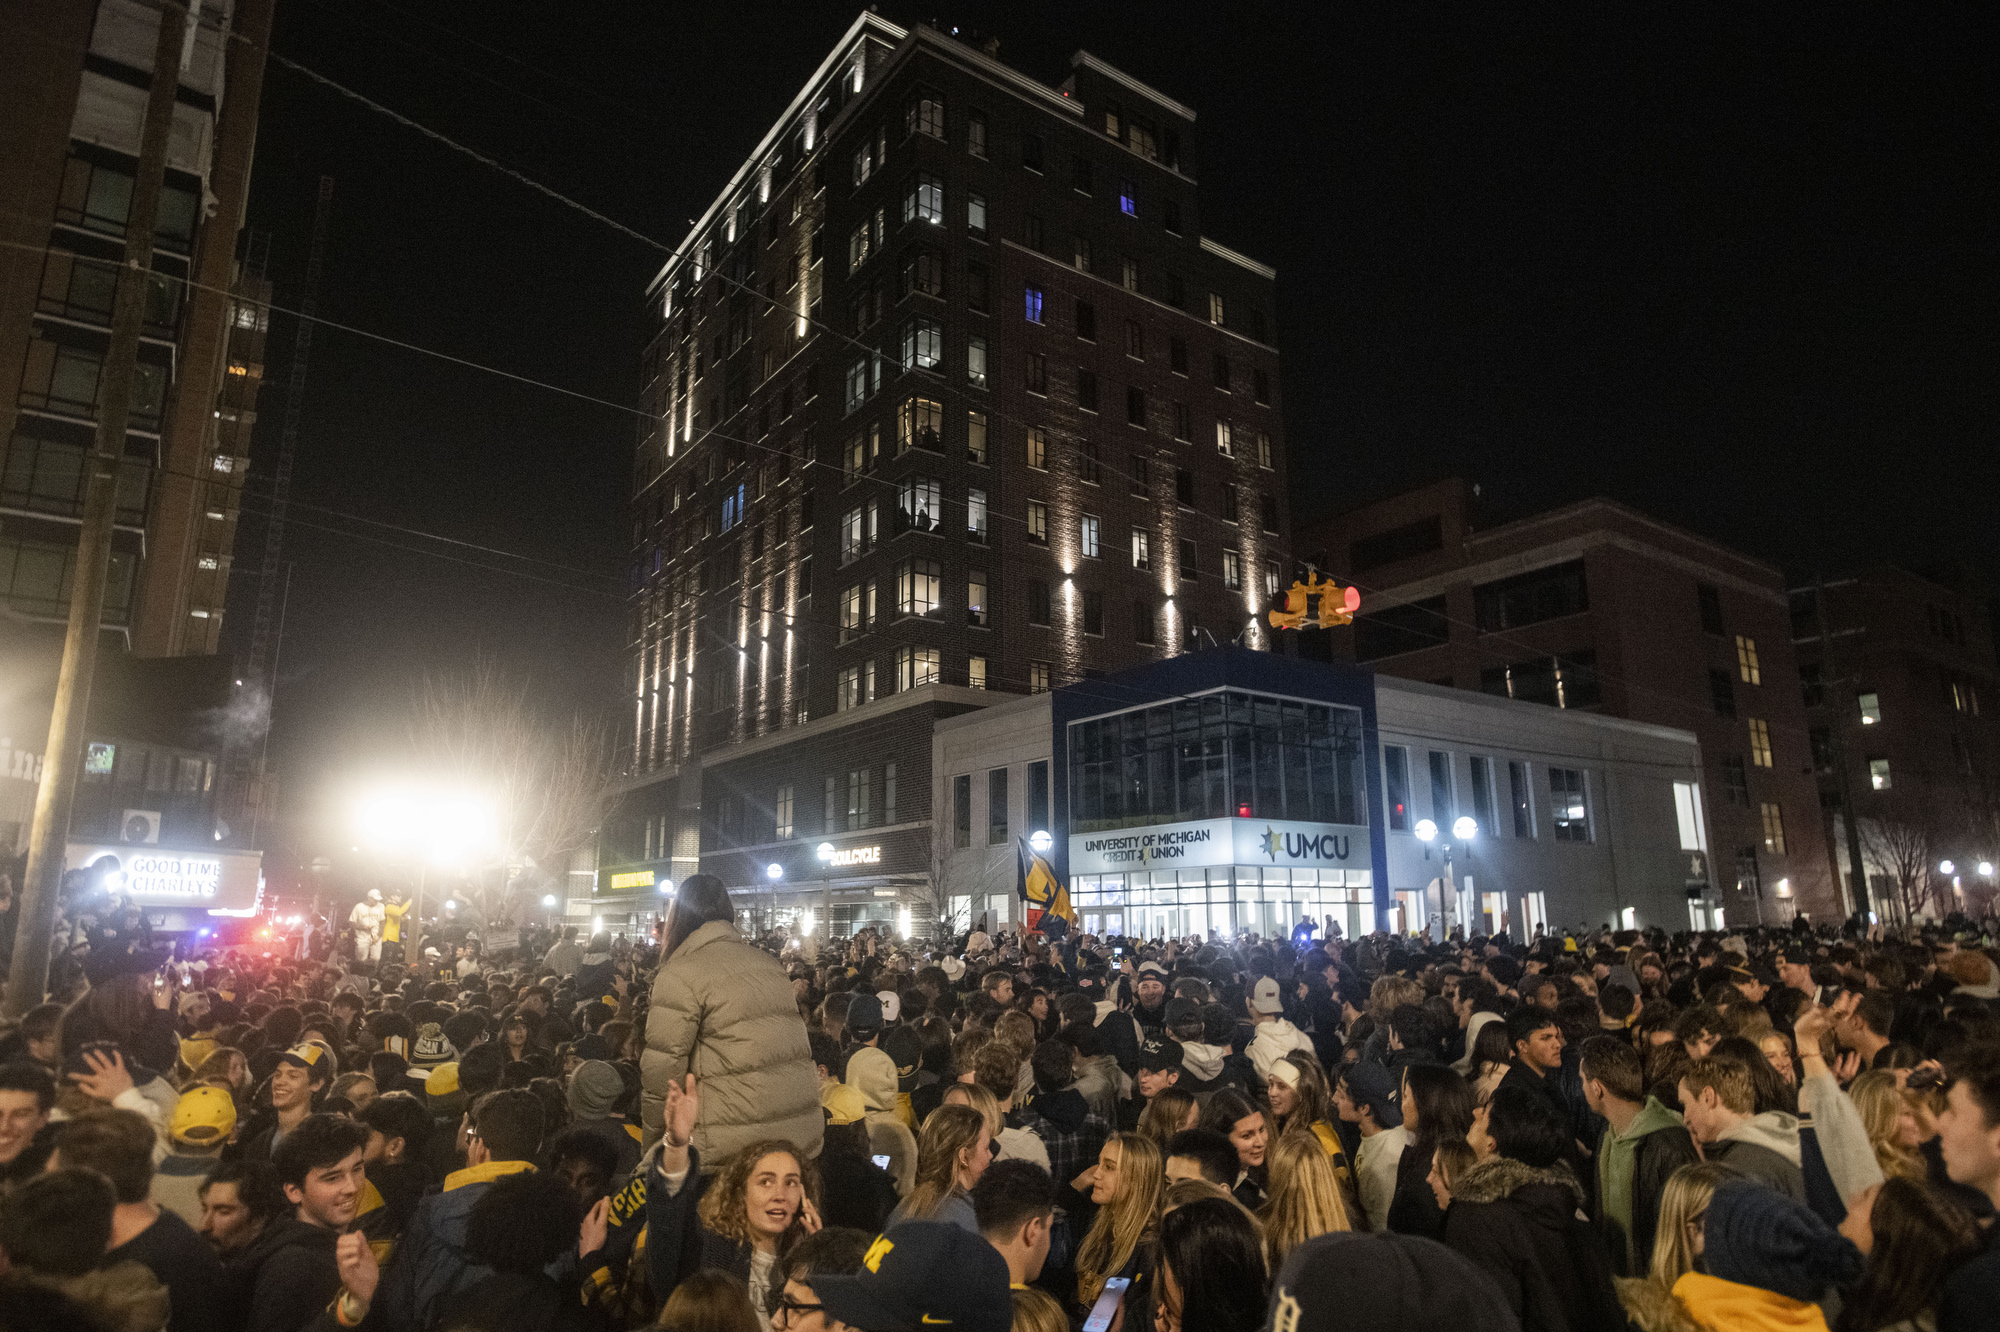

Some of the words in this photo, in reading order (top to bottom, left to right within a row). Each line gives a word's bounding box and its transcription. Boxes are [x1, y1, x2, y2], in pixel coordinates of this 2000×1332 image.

[1085, 836, 1140, 852] UNIVERSITY
[1142, 834, 1156, 847] OF
[1158, 829, 1210, 846] MICHIGAN
[1286, 832, 1350, 860] UMCU
[1102, 850, 1136, 863] CREDIT
[1151, 845, 1184, 859] UNION
[134, 859, 181, 874] GOOD
[187, 862, 221, 877] TIME
